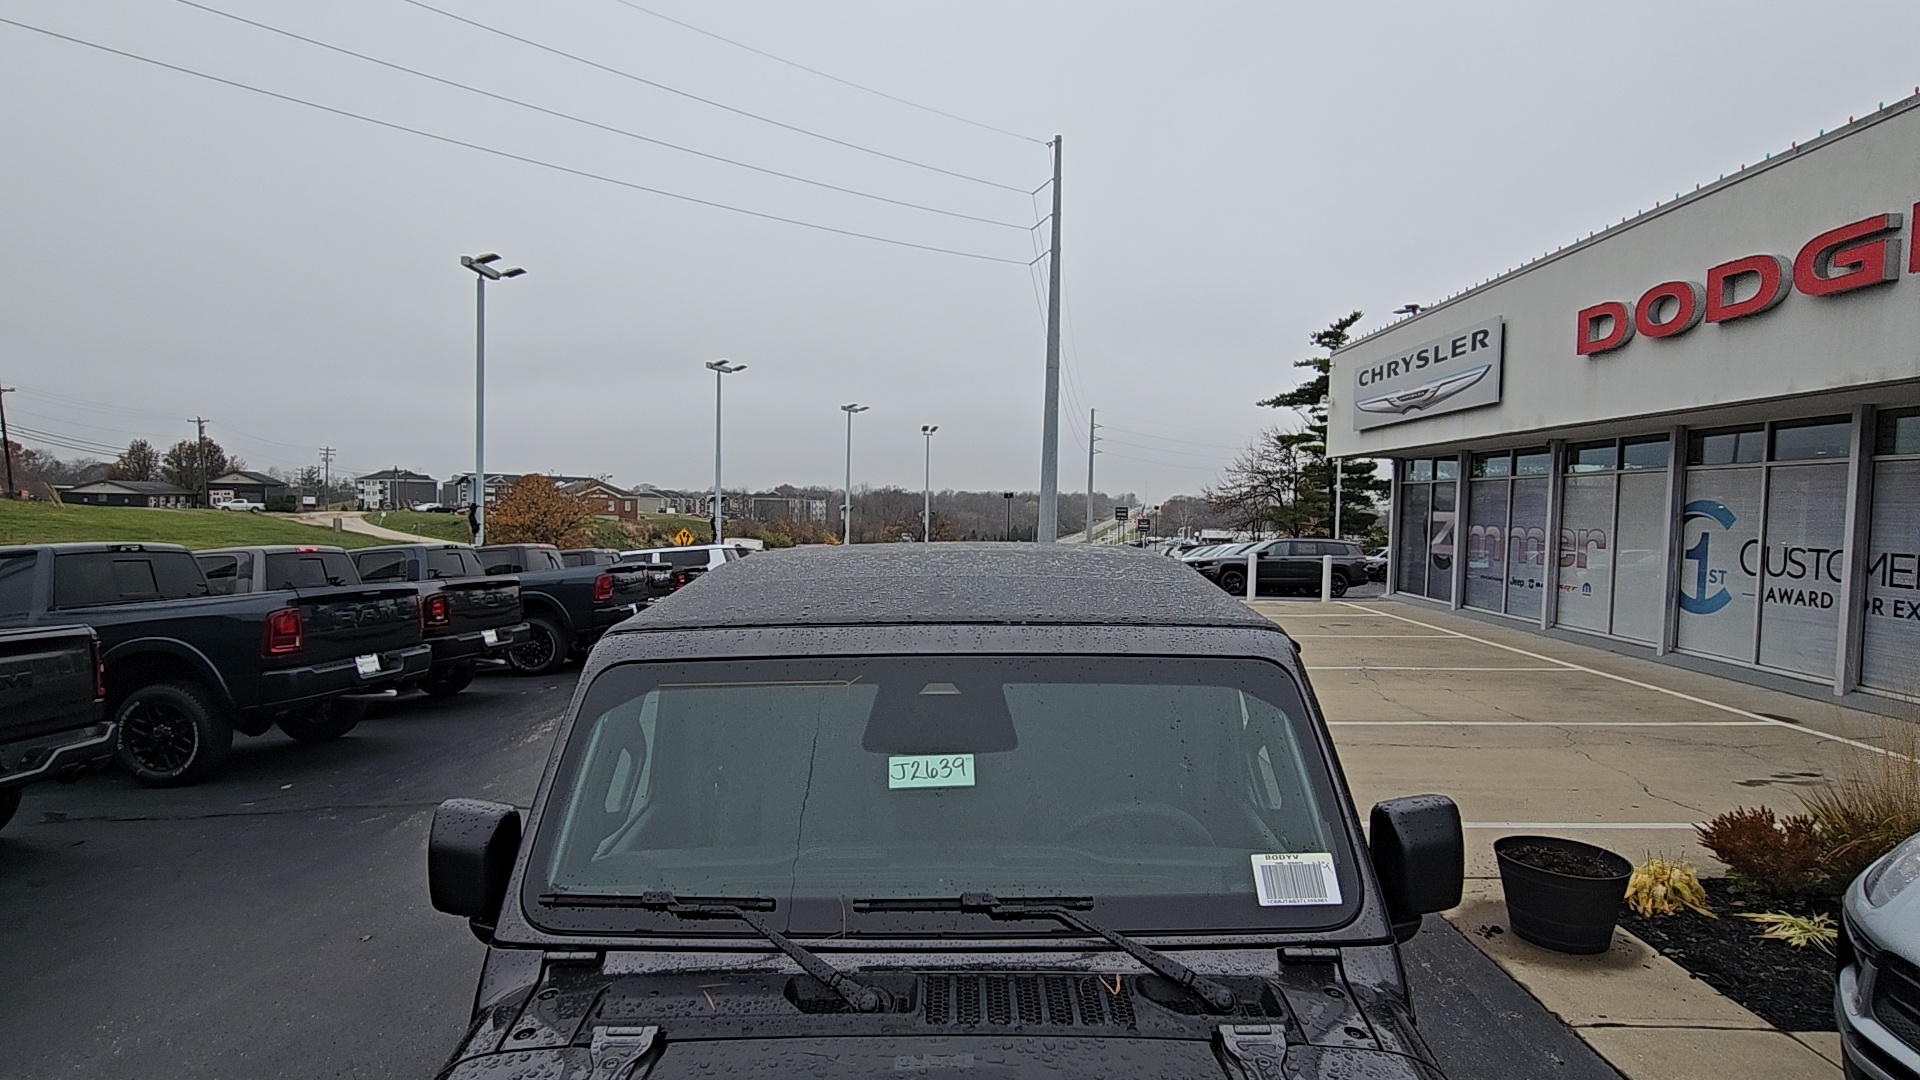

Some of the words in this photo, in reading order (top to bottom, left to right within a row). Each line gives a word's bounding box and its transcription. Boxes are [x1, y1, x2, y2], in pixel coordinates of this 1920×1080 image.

[1576, 202, 1920, 355] DODG
[1359, 329, 1490, 387] CHRYSLER
[1431, 511, 1606, 569] Zmmer
[1510, 576, 1525, 588] Jeep
[1765, 587, 1834, 609] AWARD
[334, 602, 399, 629] RAM
[891, 757, 966, 781] J2639
